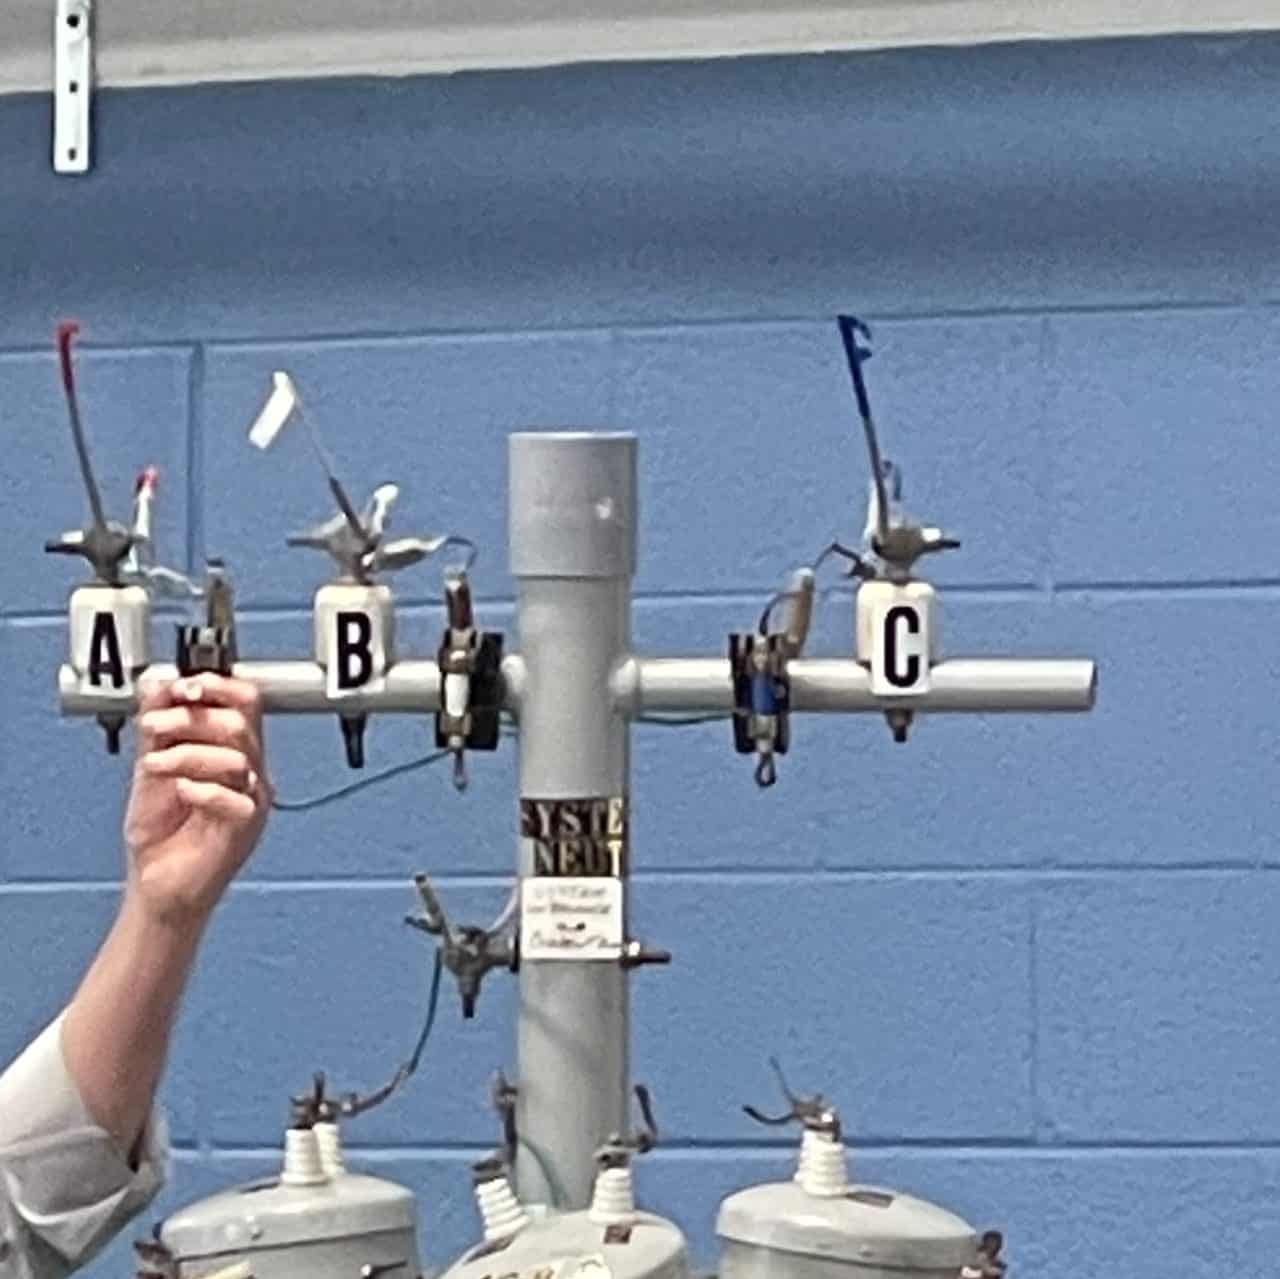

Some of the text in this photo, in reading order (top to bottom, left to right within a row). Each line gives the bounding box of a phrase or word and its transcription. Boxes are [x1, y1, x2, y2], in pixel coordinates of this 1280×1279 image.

[88, 611, 124, 688] A
[336, 611, 371, 689] B
[884, 606, 920, 688] C
